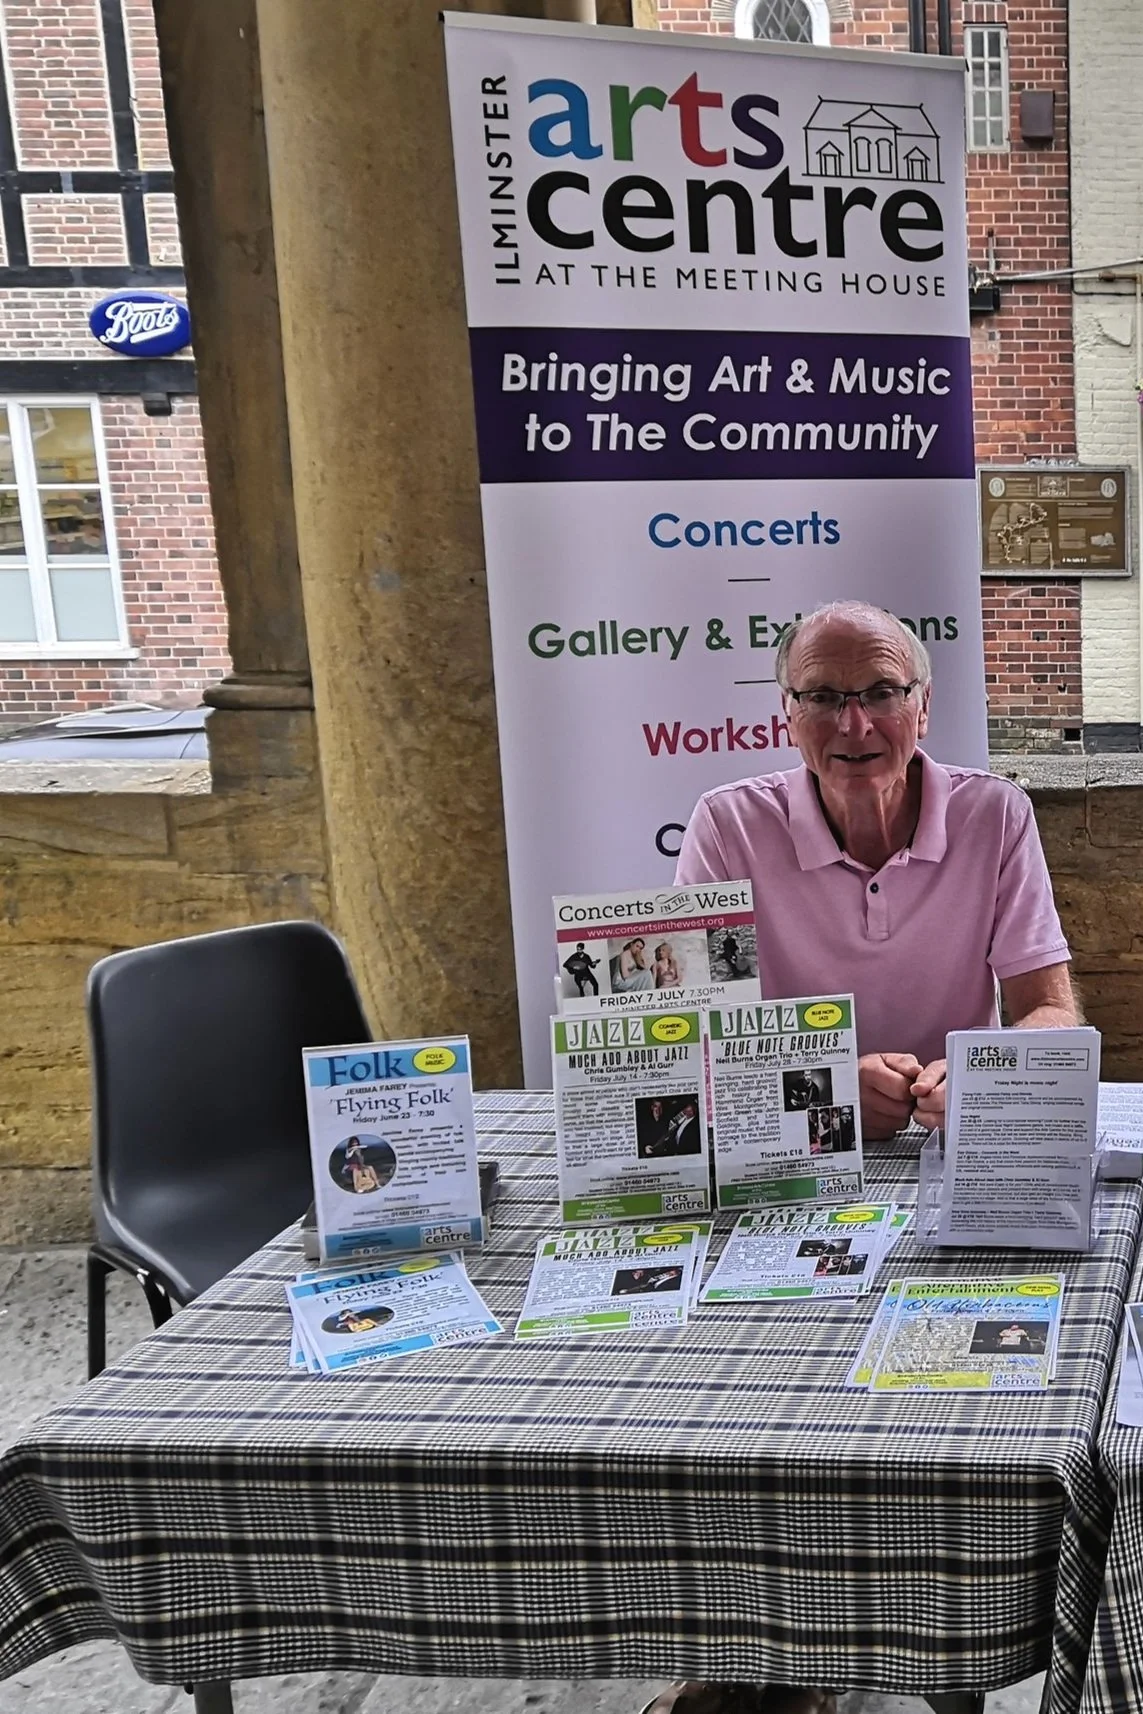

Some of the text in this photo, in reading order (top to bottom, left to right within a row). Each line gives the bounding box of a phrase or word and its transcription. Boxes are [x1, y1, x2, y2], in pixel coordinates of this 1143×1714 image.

[527, 72, 785, 170] arts
[481, 75, 520, 284] ILMINSTER
[526, 166, 944, 262] centre
[535, 264, 946, 297] AT THE MEETING HOUSE
[99, 301, 180, 343] Boots
[502, 352, 951, 402] Bringing Art & Music
[525, 413, 938, 459] to The Community
[648, 511, 841, 549] Concerts
[528, 620, 690, 661] Gallery
[705, 617, 732, 650] &
[642, 716, 795, 757] Worksh
[559, 891, 749, 922] Concerts IN THE West
[587, 916, 724, 937] www.concertsinthewest.org
[600, 987, 725, 1007] FRIDAY 7 JULY 7.30PM
[725, 1008, 795, 1033] JAZZ
[570, 1021, 641, 1046] JAZZ
[757, 1037, 784, 1053] NOTE
[569, 1054, 596, 1068] MUCH
[627, 1049, 658, 1064] ABOUT
[665, 1046, 688, 1060] JAZZ
[971, 1056, 1017, 1067] centre
[972, 1046, 999, 1057] arts
[325, 1051, 407, 1089] Folk
[584, 1067, 604, 1075] Chris
[820, 1177, 842, 1187] arts
[821, 1184, 857, 1194] centre
[665, 1193, 688, 1202] arts
[666, 1200, 703, 1211] centre
[424, 1225, 452, 1235] arts
[426, 1232, 471, 1244] centre
[558, 1237, 632, 1251] JAZZ
[311, 1271, 390, 1294] Folk
